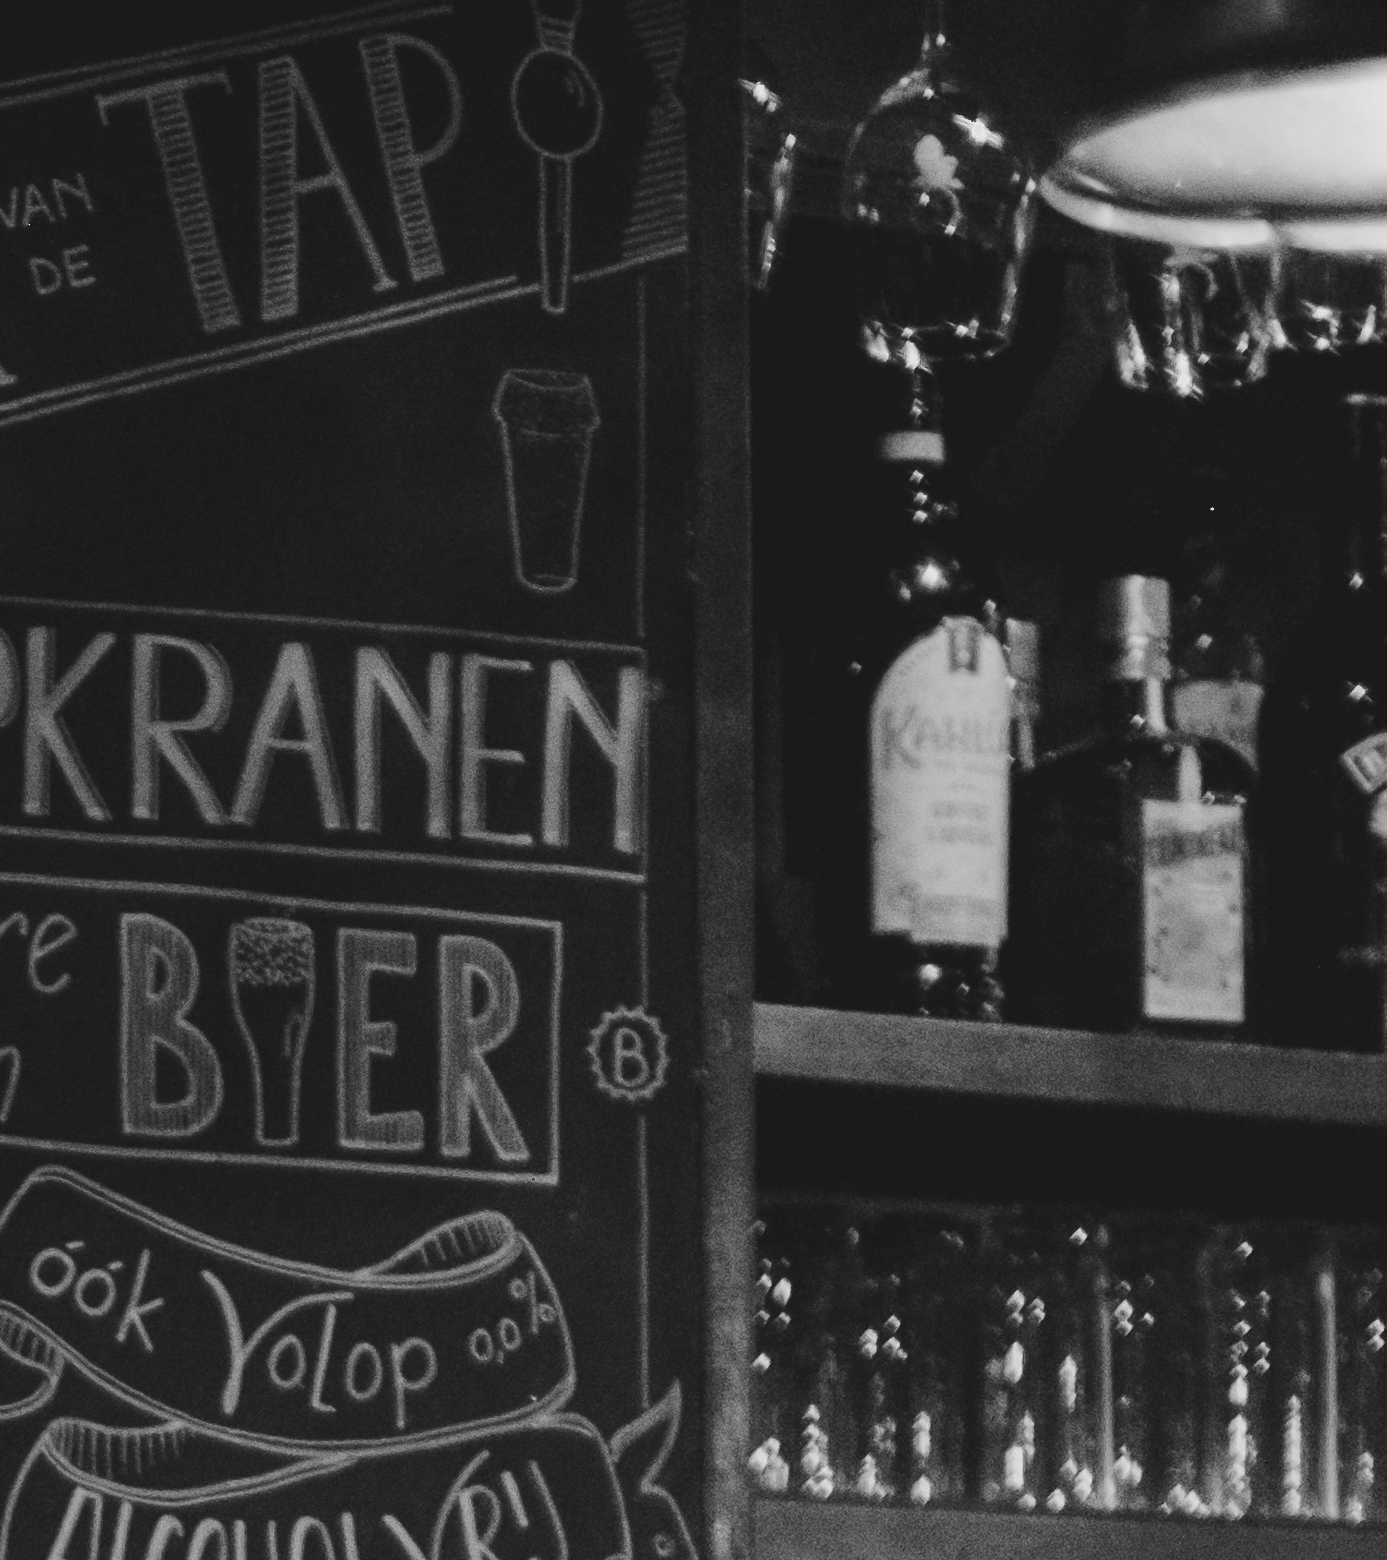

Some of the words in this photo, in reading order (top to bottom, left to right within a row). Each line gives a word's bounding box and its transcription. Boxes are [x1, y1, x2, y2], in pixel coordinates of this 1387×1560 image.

[29, 244, 96, 295] DE
[97, 33, 462, 332] TAP
[118, 911, 530, 1163] BIER
